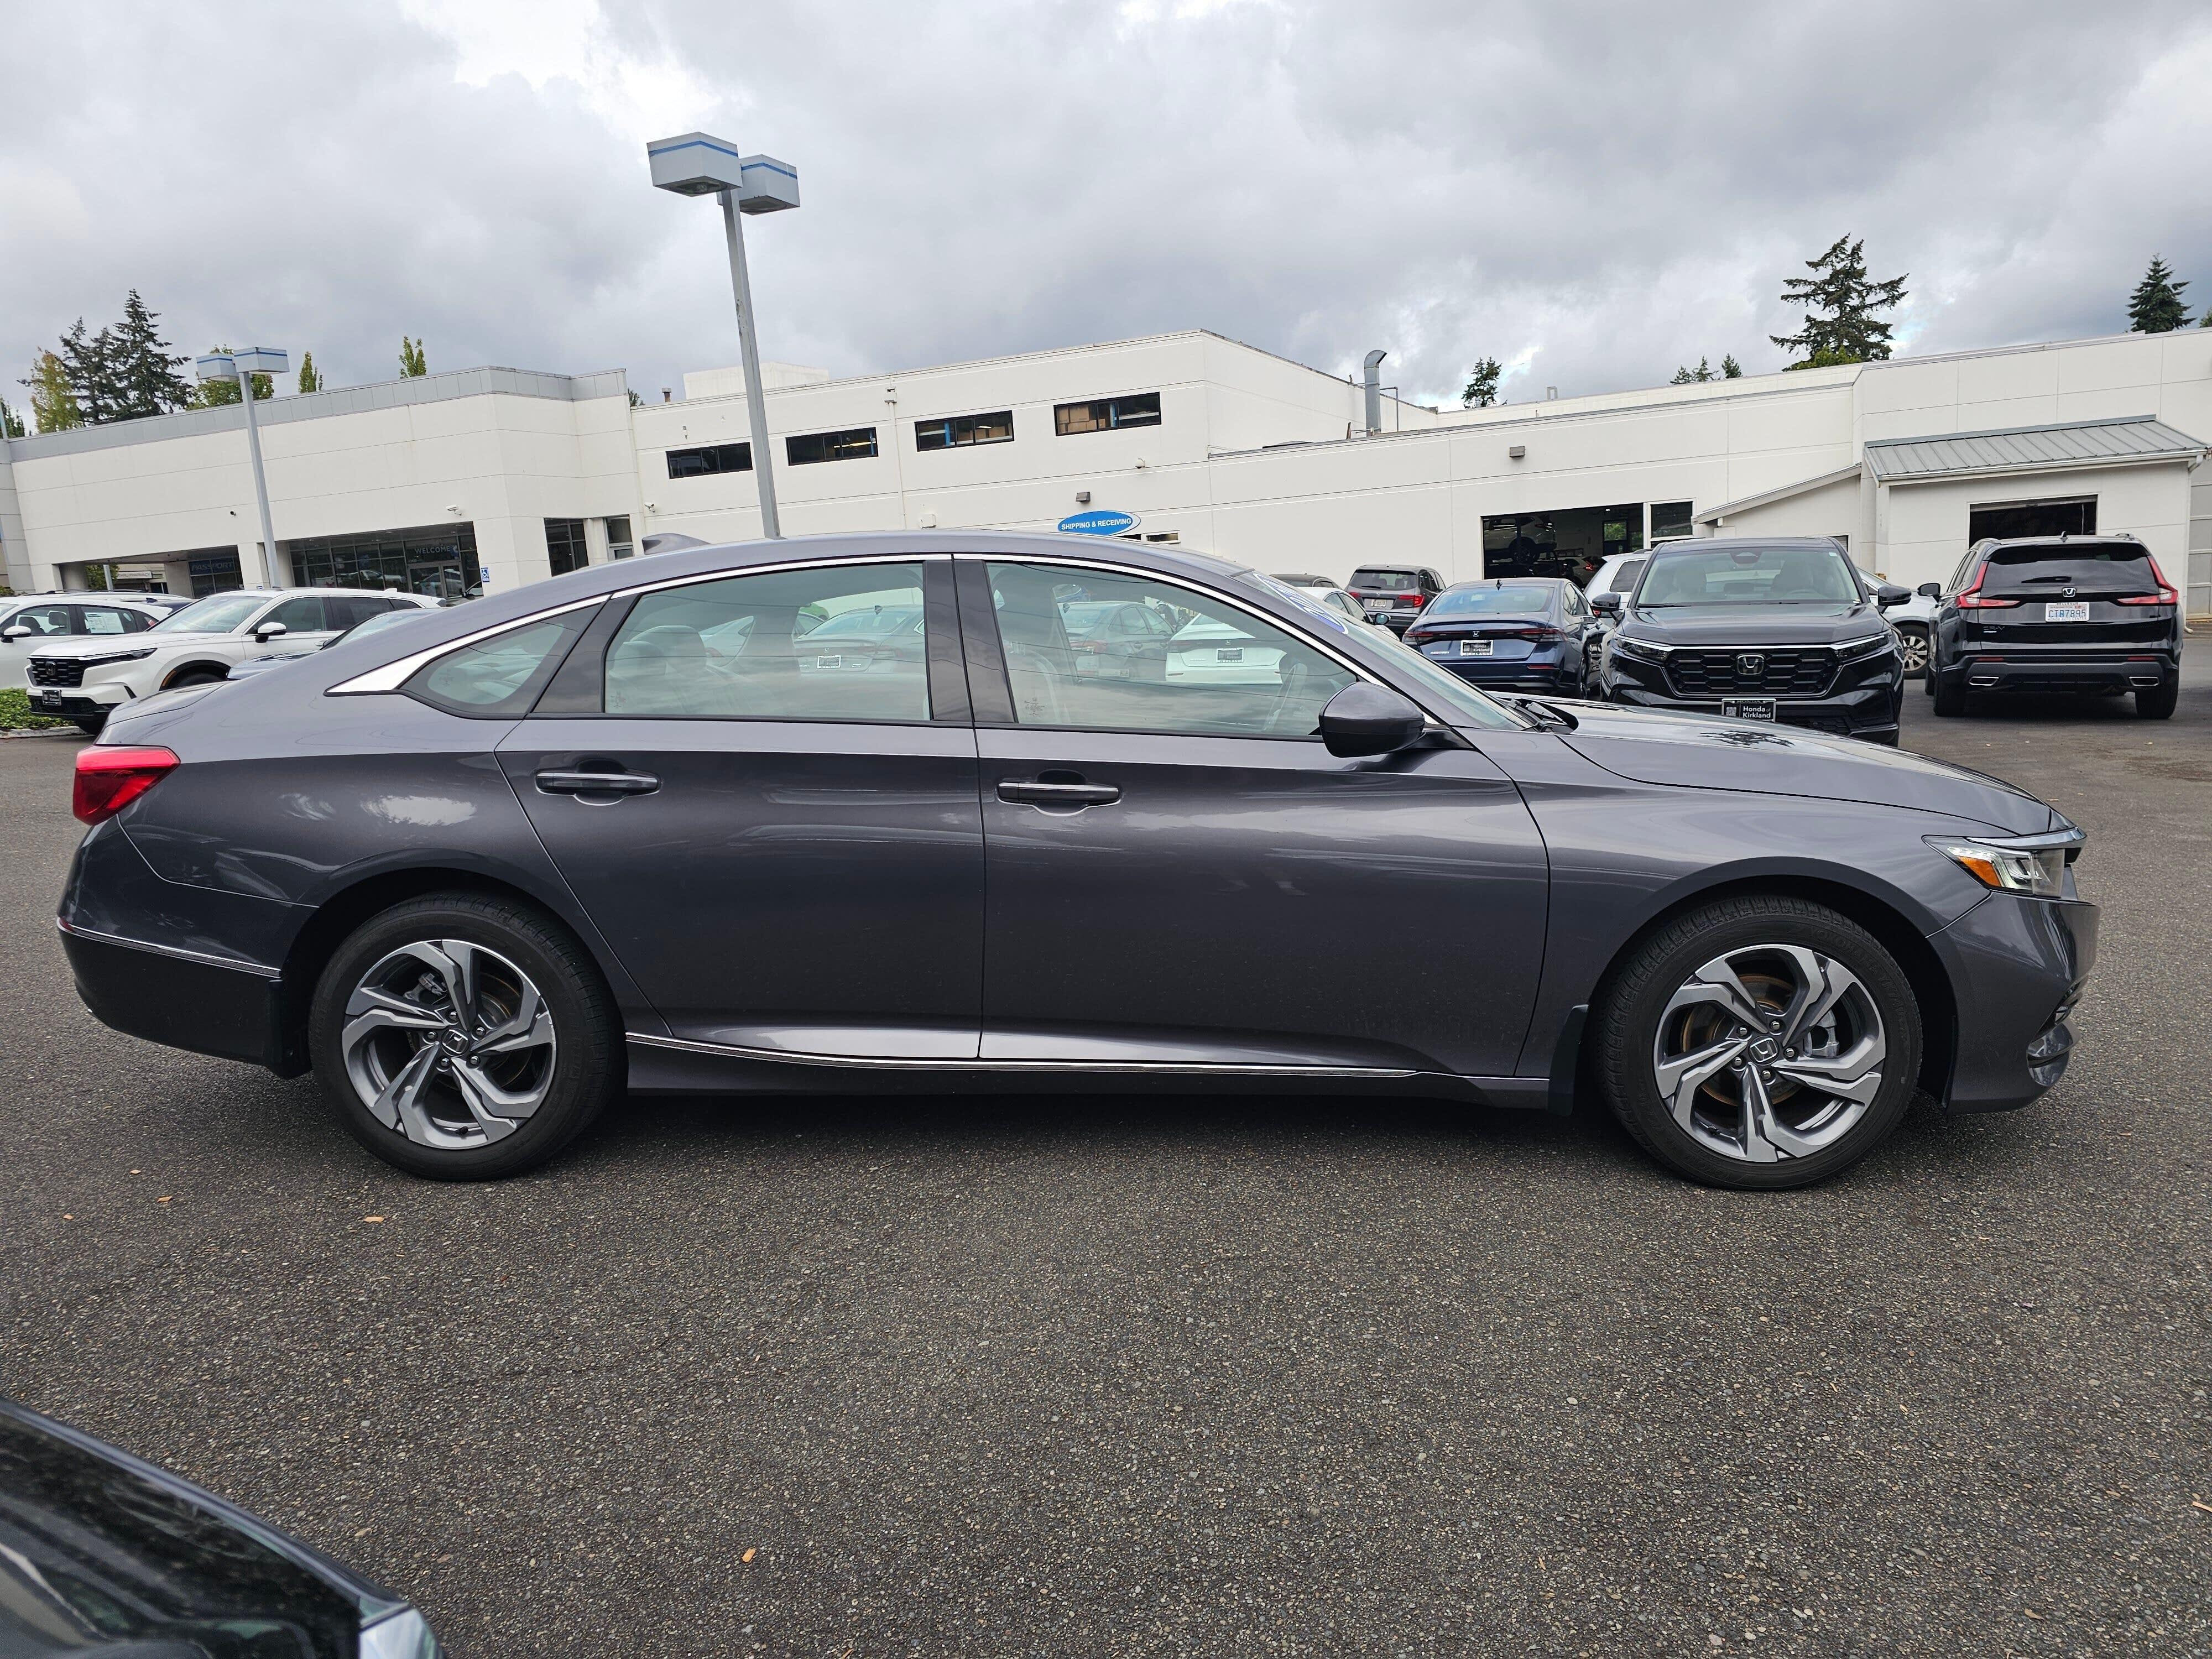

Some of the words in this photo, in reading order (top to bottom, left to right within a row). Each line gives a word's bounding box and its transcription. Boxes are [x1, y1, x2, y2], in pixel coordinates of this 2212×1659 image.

[1061, 521, 1091, 530] SHIPPING
[1097, 518, 1132, 527] RECEIVING
[191, 561, 233, 571] PASSPORT
